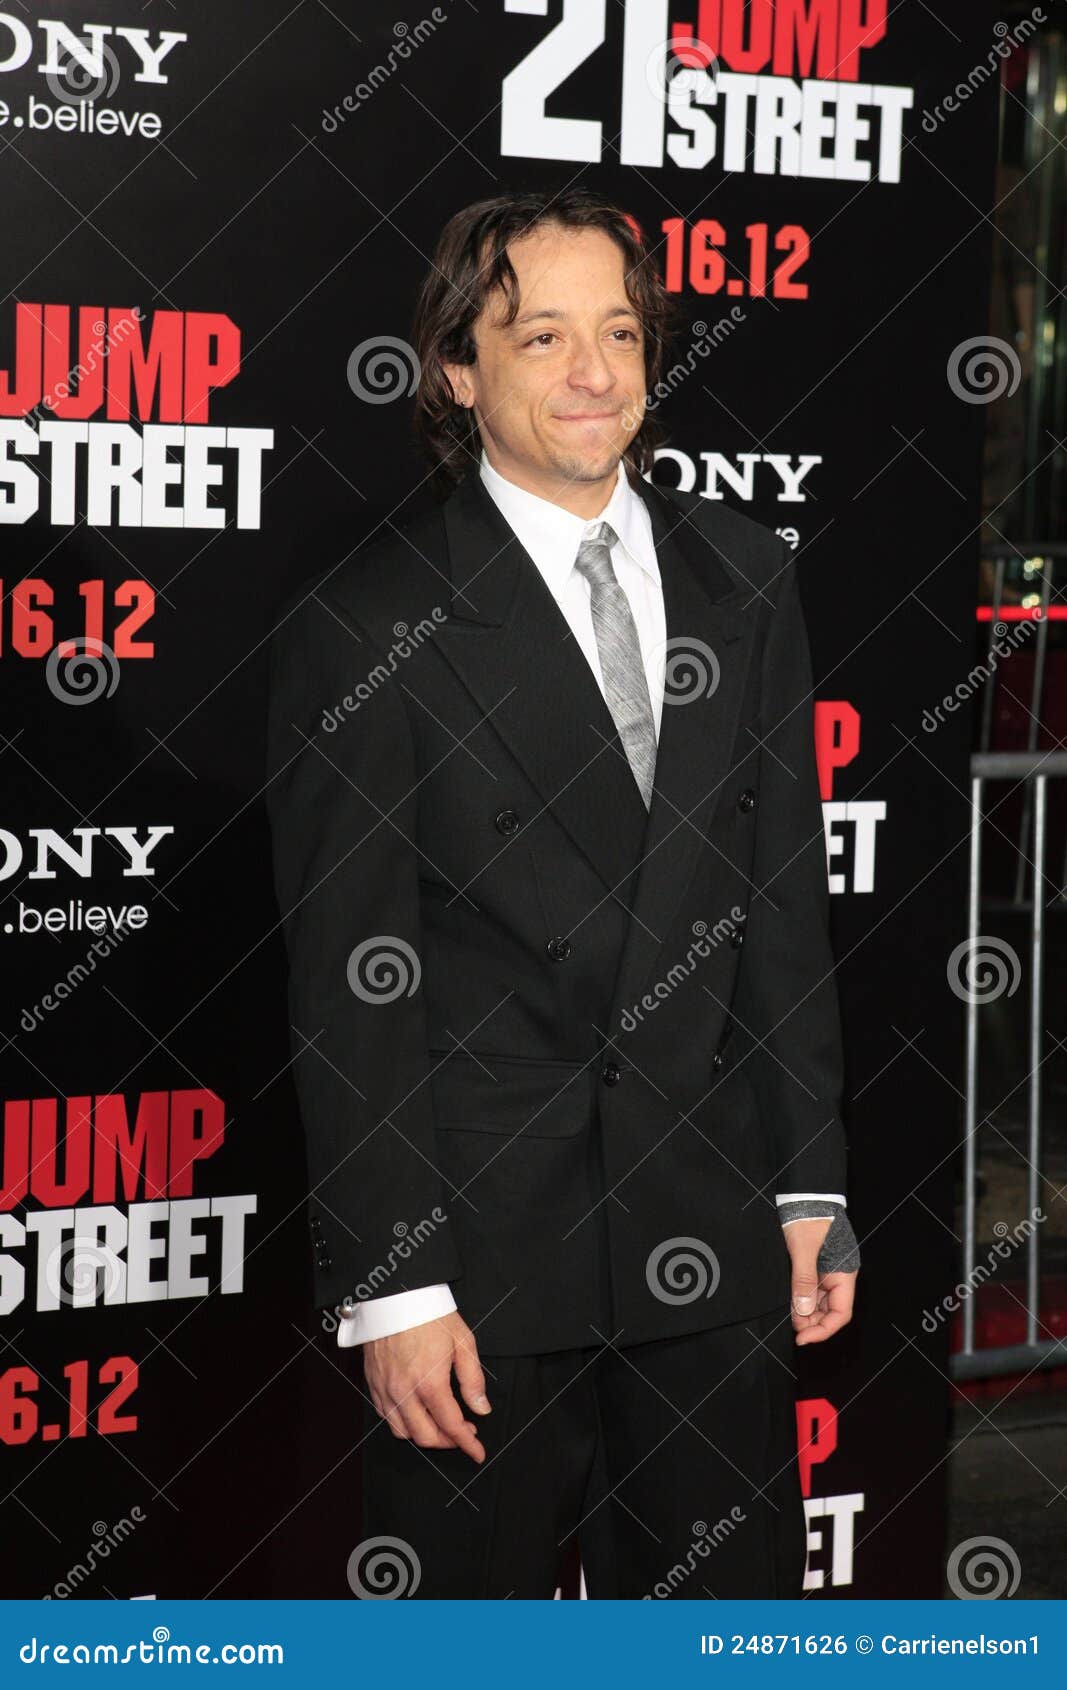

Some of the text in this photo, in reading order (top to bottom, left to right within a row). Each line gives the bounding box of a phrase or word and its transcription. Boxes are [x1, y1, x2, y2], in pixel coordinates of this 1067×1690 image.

[501, 0, 669, 168] 21
[671, 0, 888, 82] JUMP
[667, 68, 914, 184] STREET
[0, 303, 241, 424] JUMP
[0, 418, 275, 530] STREET
[0, 578, 156, 659] 6.12
[0, 1088, 226, 1212] JUMP
